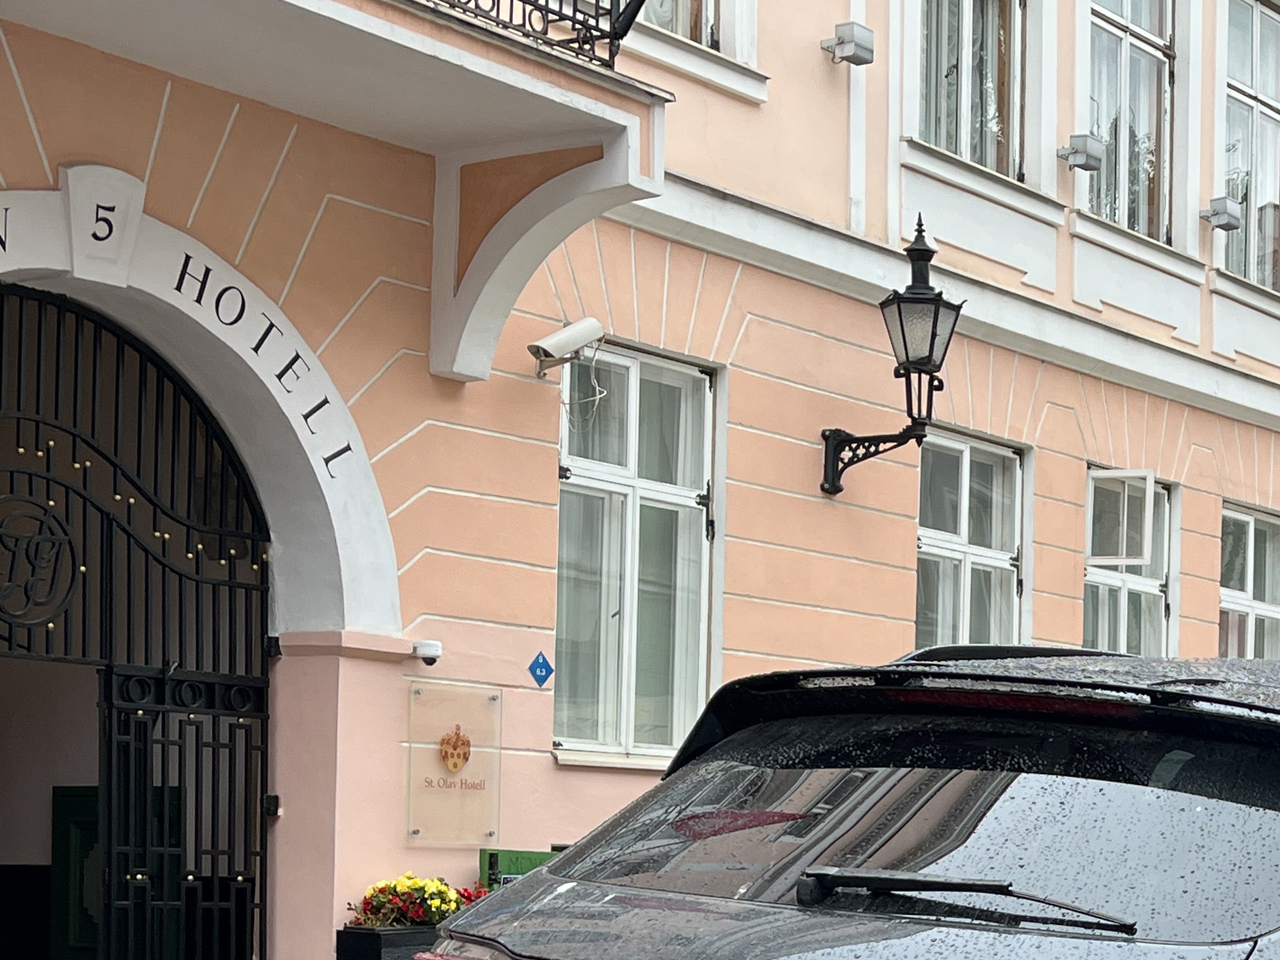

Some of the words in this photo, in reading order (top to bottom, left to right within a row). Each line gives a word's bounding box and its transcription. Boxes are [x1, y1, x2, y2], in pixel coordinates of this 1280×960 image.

[91, 203, 117, 242] 5
[172, 251, 354, 480] HOTELL
[437, 777, 457, 789] Olav
[460, 778, 486, 790] Hotell
